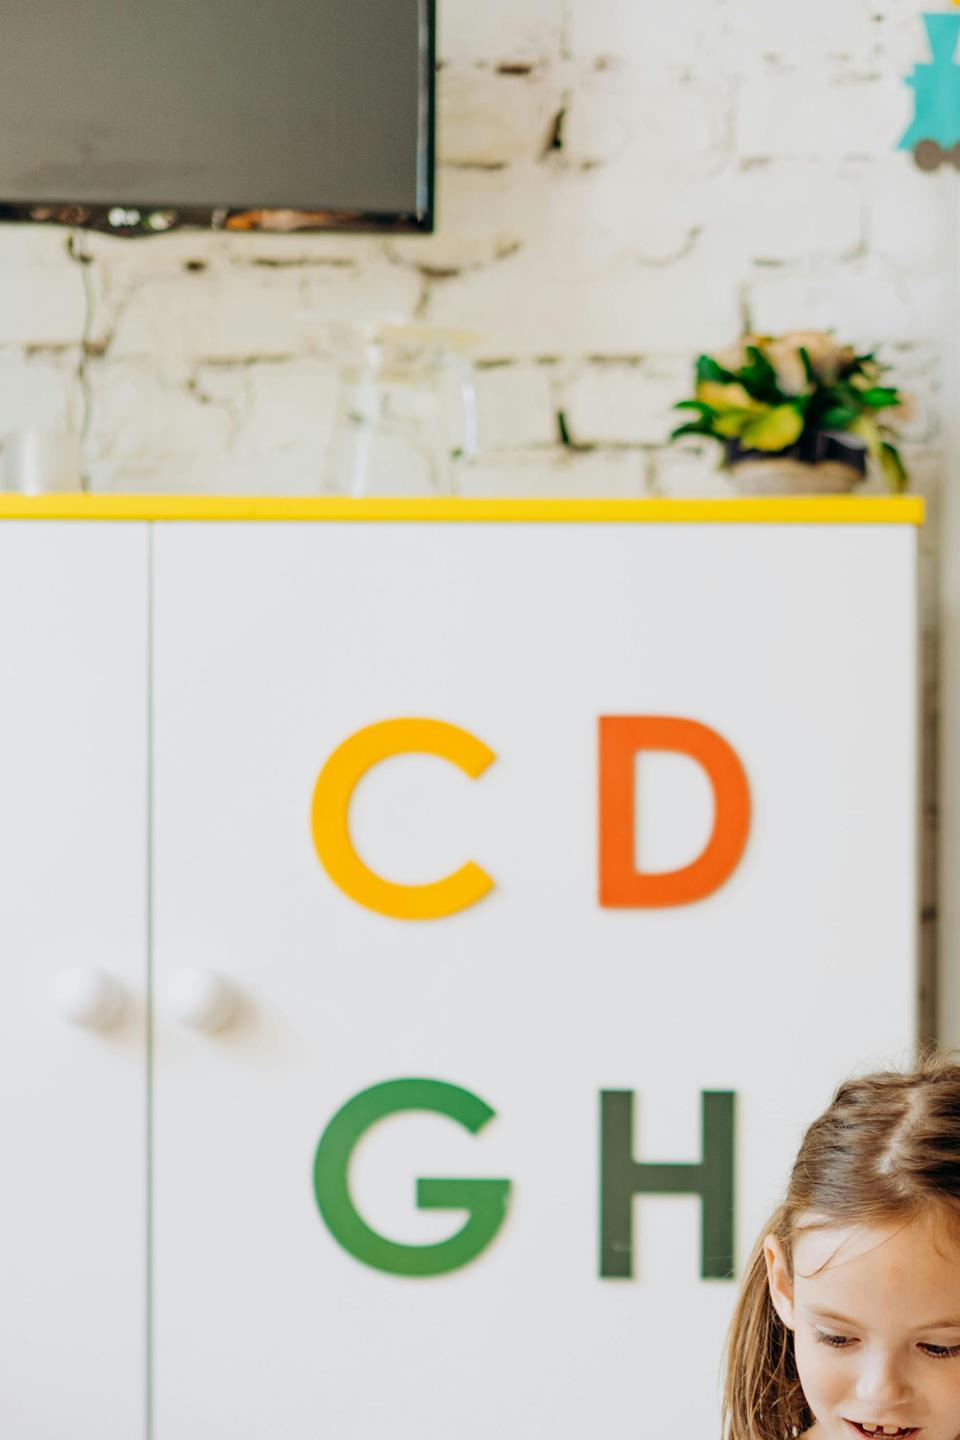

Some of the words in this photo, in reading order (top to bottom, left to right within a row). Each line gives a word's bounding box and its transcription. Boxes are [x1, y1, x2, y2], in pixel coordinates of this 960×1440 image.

[310, 716, 498, 922] C
[597, 714, 753, 909] D
[313, 1077, 512, 1277] G
[599, 1089, 737, 1279] H
